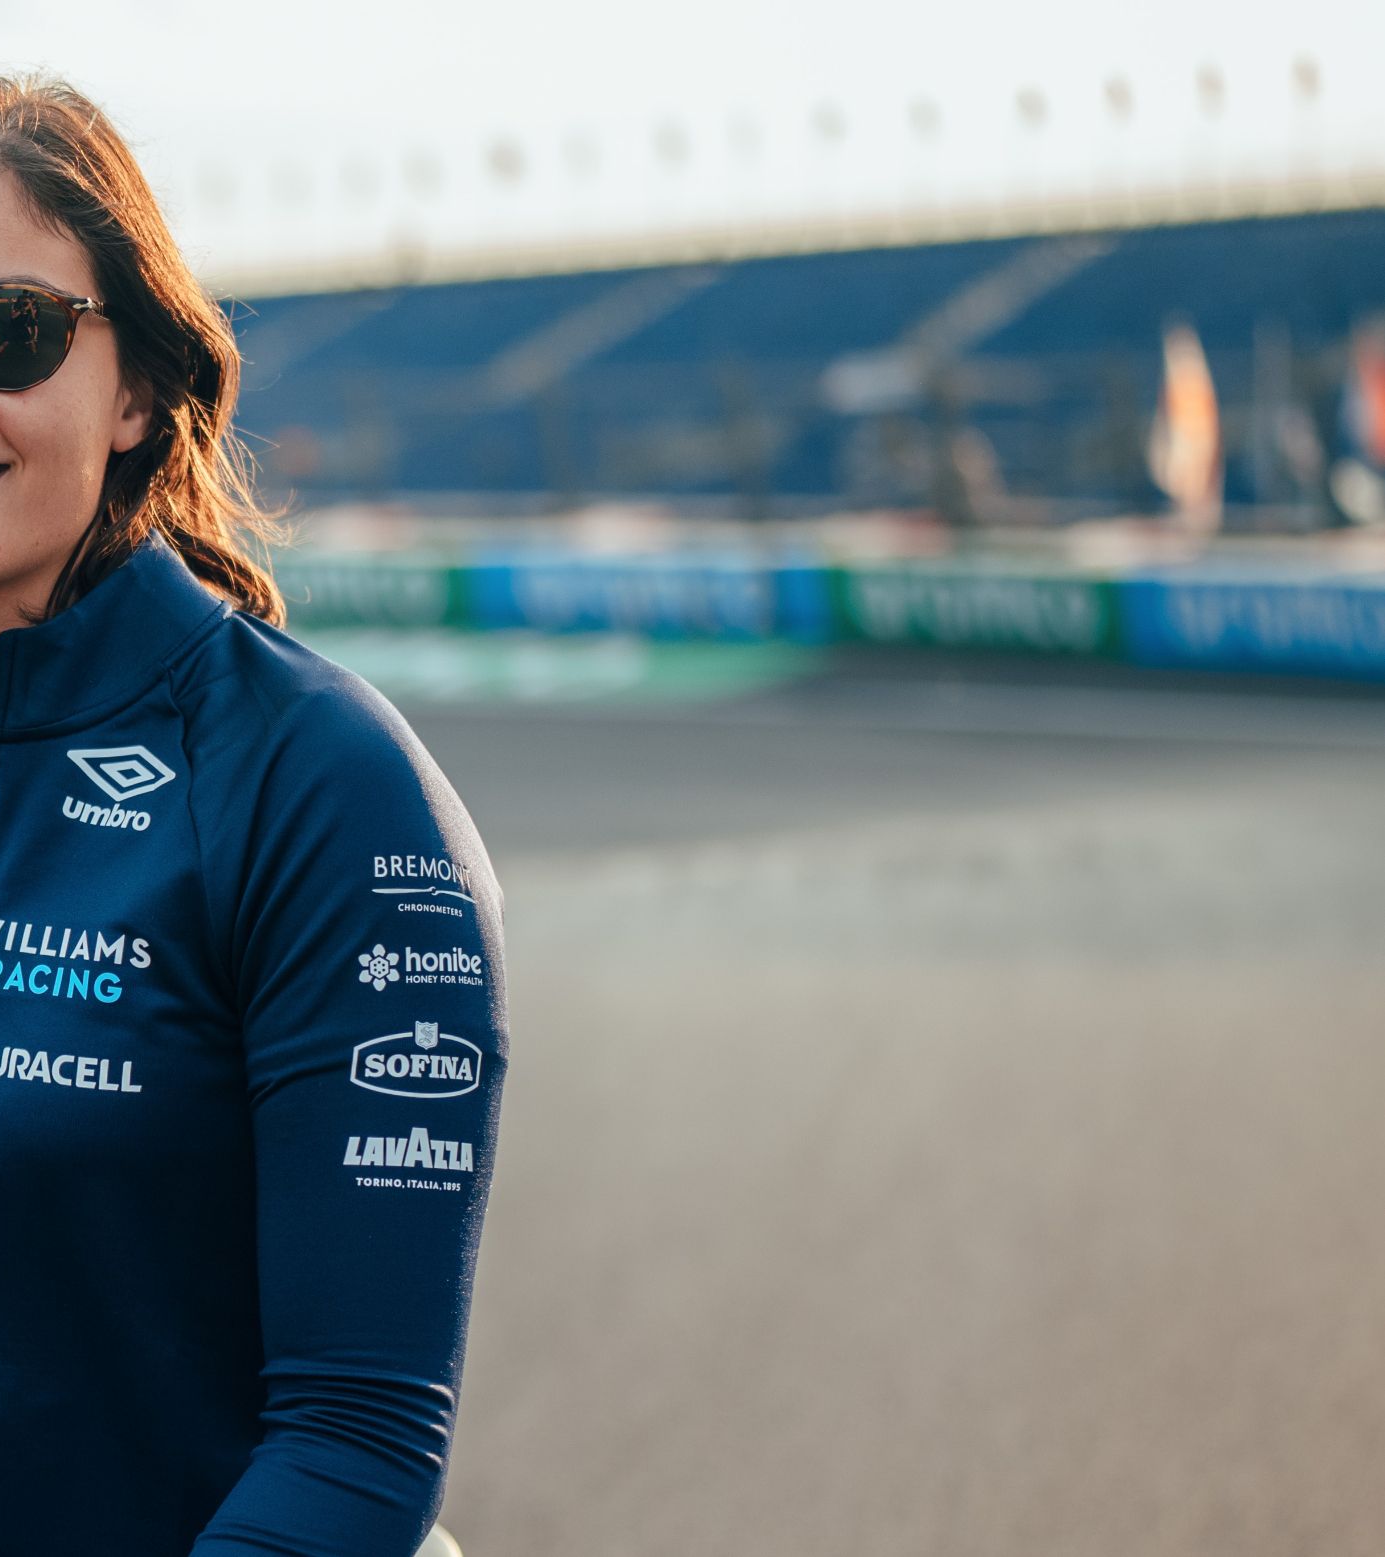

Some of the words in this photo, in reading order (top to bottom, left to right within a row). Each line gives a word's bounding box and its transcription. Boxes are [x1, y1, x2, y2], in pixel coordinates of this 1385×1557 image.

[62, 796, 152, 832] umbro
[397, 903, 463, 918] CHRONOMETERS
[405, 946, 482, 975] honibe
[405, 974, 438, 985] HONEY
[440, 974, 457, 985] FOR
[458, 975, 484, 987] HEALTH
[364, 1053, 474, 1082] SOFINA
[342, 1126, 475, 1173] LAVAZZA
[442, 1181, 462, 1192] 1895
